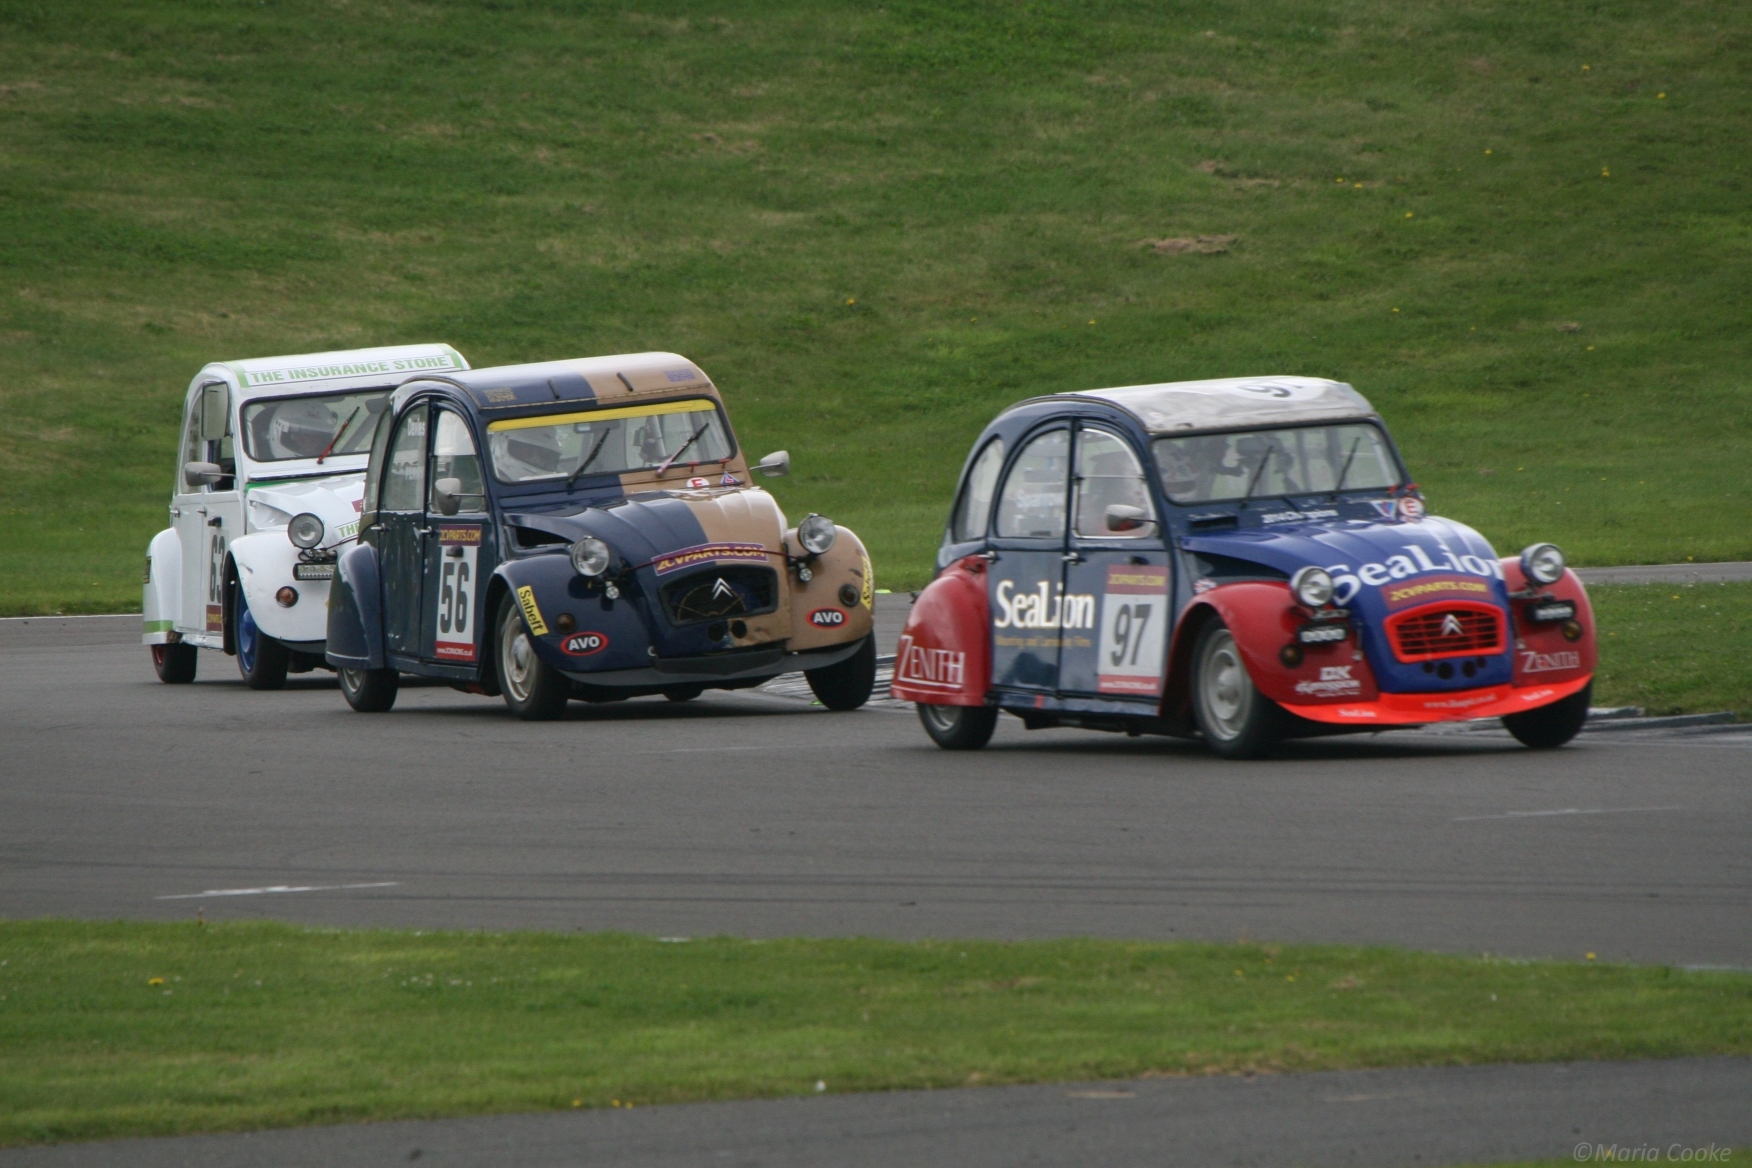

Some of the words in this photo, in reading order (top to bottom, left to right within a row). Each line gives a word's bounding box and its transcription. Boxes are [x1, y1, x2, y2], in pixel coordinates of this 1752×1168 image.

[250, 370, 285, 384] THE
[288, 361, 390, 380] INSURANCE
[394, 356, 449, 370] STORE
[657, 546, 766, 571] 2CVPARTS.COM
[440, 561, 470, 634] 56
[519, 589, 544, 632] Sabelt
[813, 611, 843, 624] AVO
[994, 579, 1095, 629] SeaLion
[568, 636, 600, 651] AVO
[1110, 603, 1153, 667] 97
[898, 634, 966, 689] ZENITH
